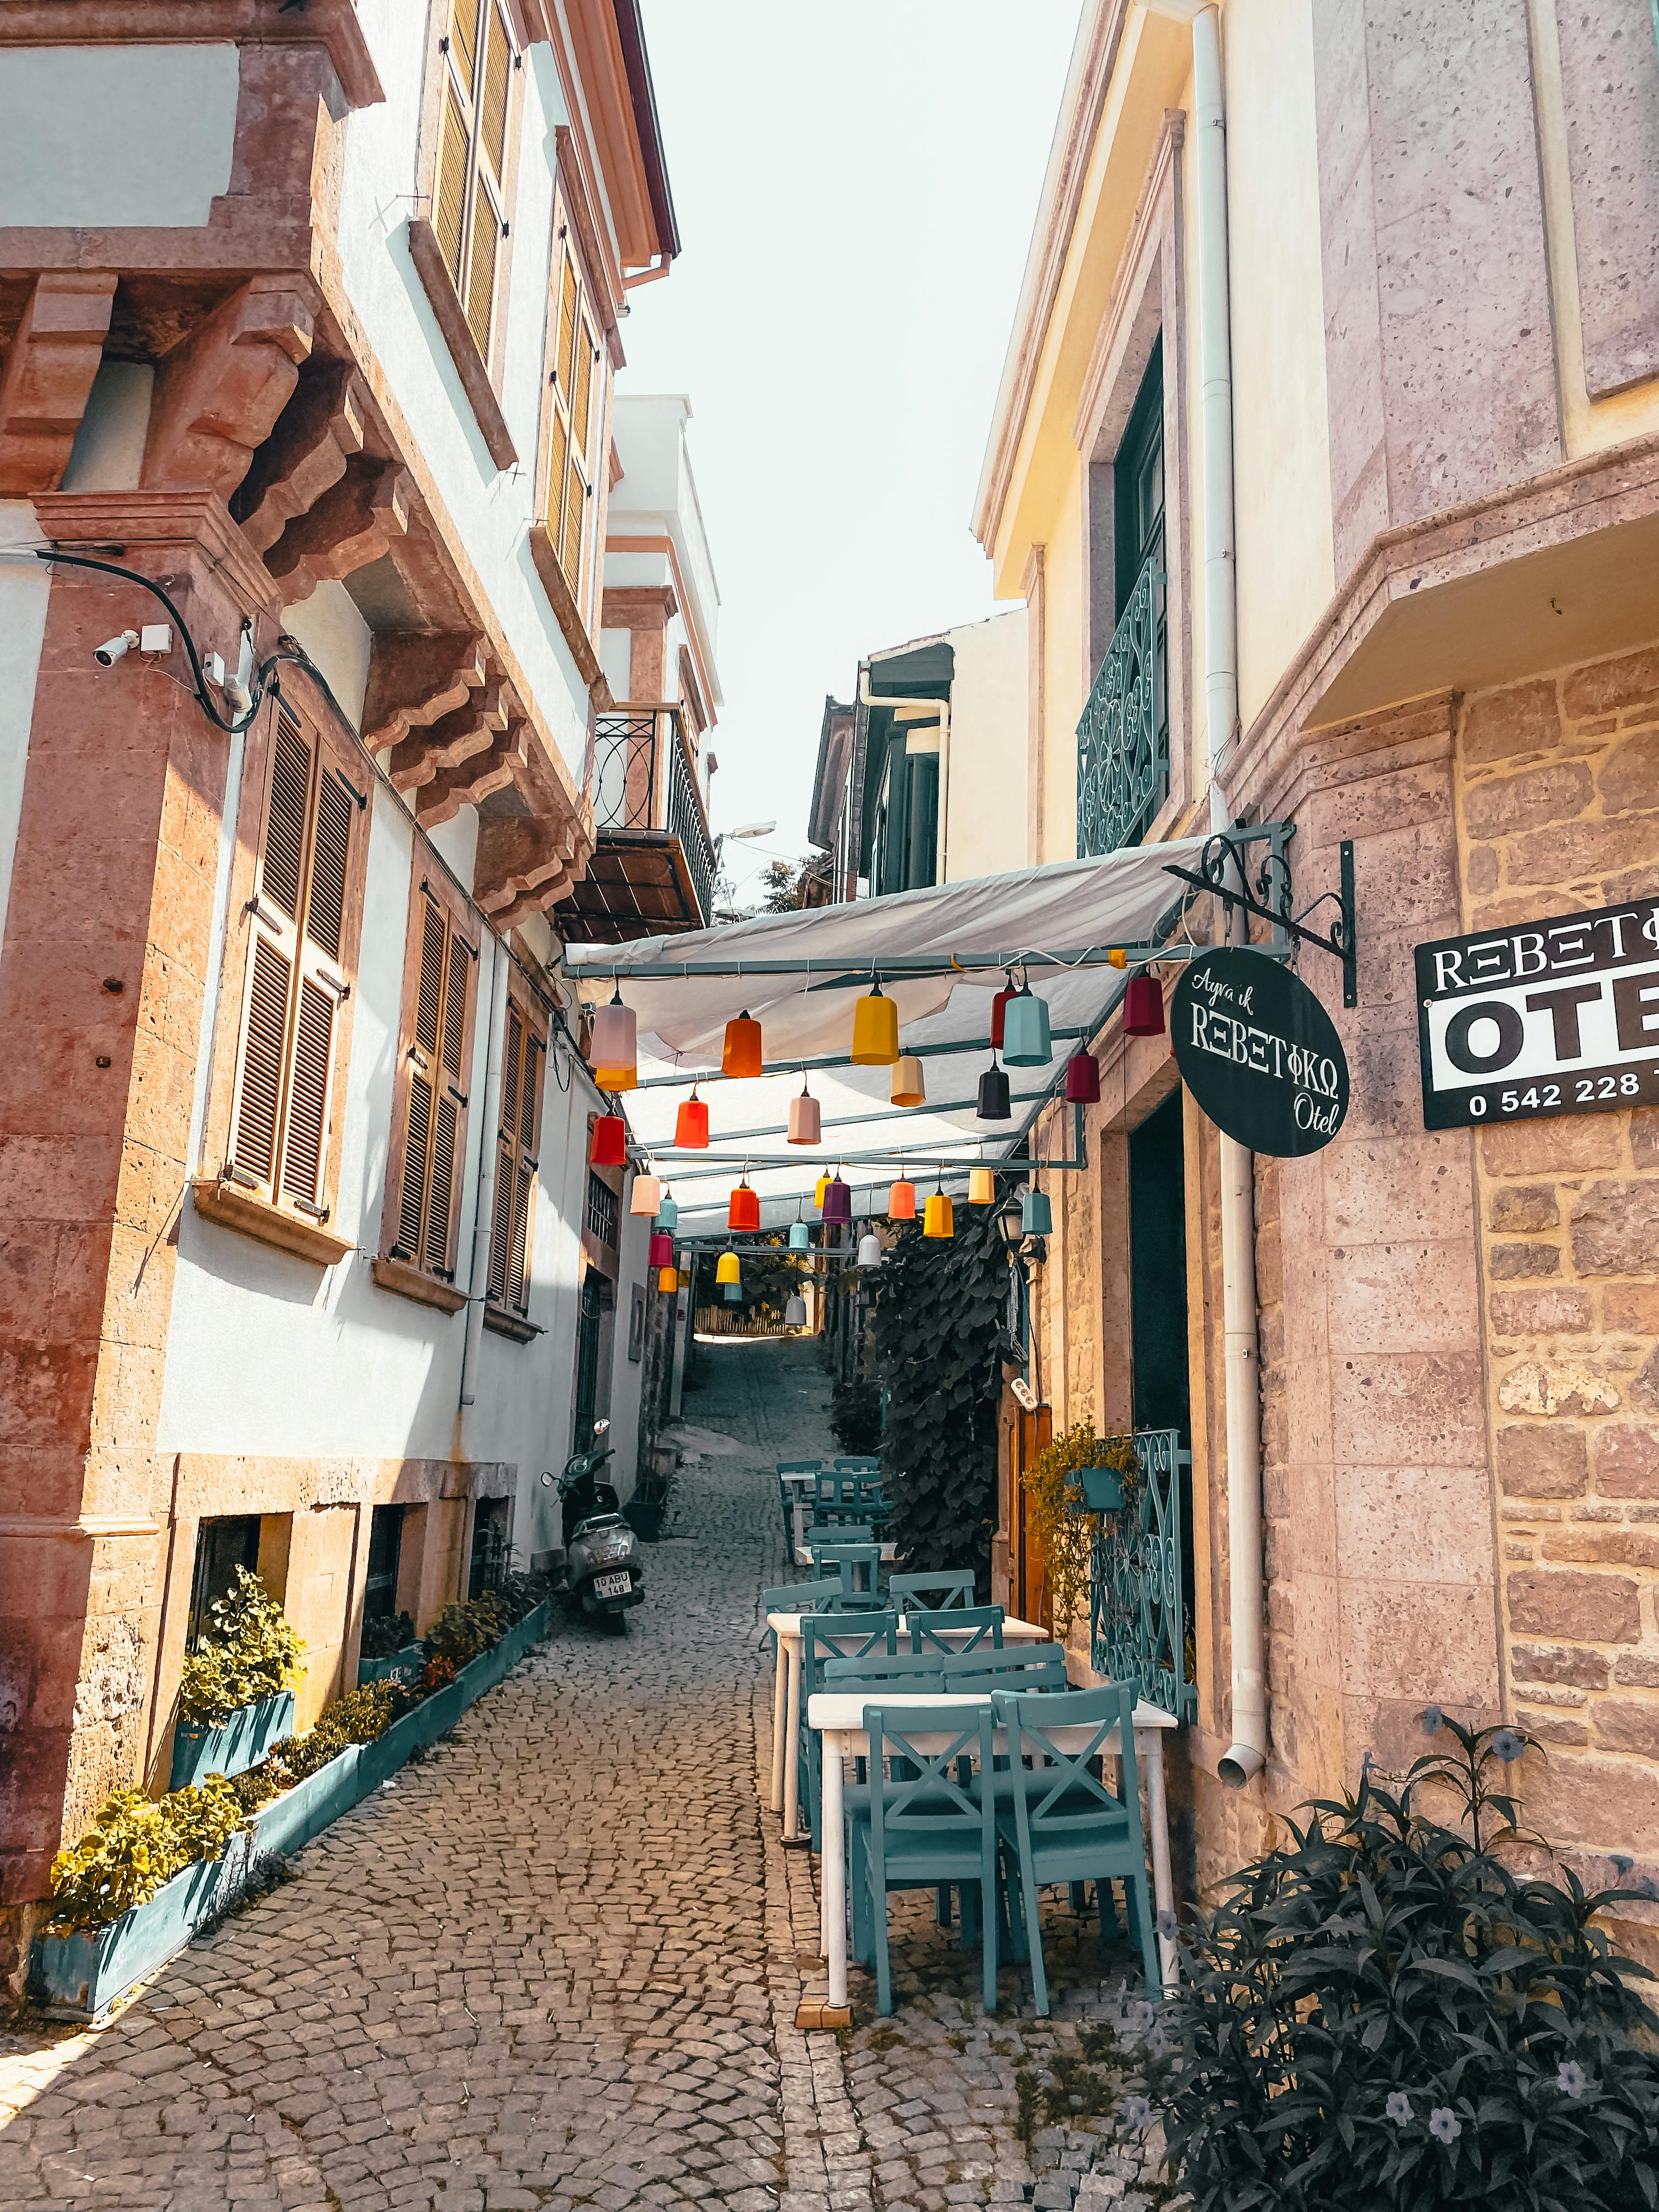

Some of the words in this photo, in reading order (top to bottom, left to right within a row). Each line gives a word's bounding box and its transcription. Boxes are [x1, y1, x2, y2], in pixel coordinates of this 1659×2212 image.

[1293, 1092, 1340, 1135] Otel
[1469, 1096, 1487, 1116] 0
[1500, 1084, 1561, 1113] 542
[1575, 1073, 1640, 1103] 228
[596, 1578, 607, 1588] 10
[609, 1572, 628, 1585] ABU
